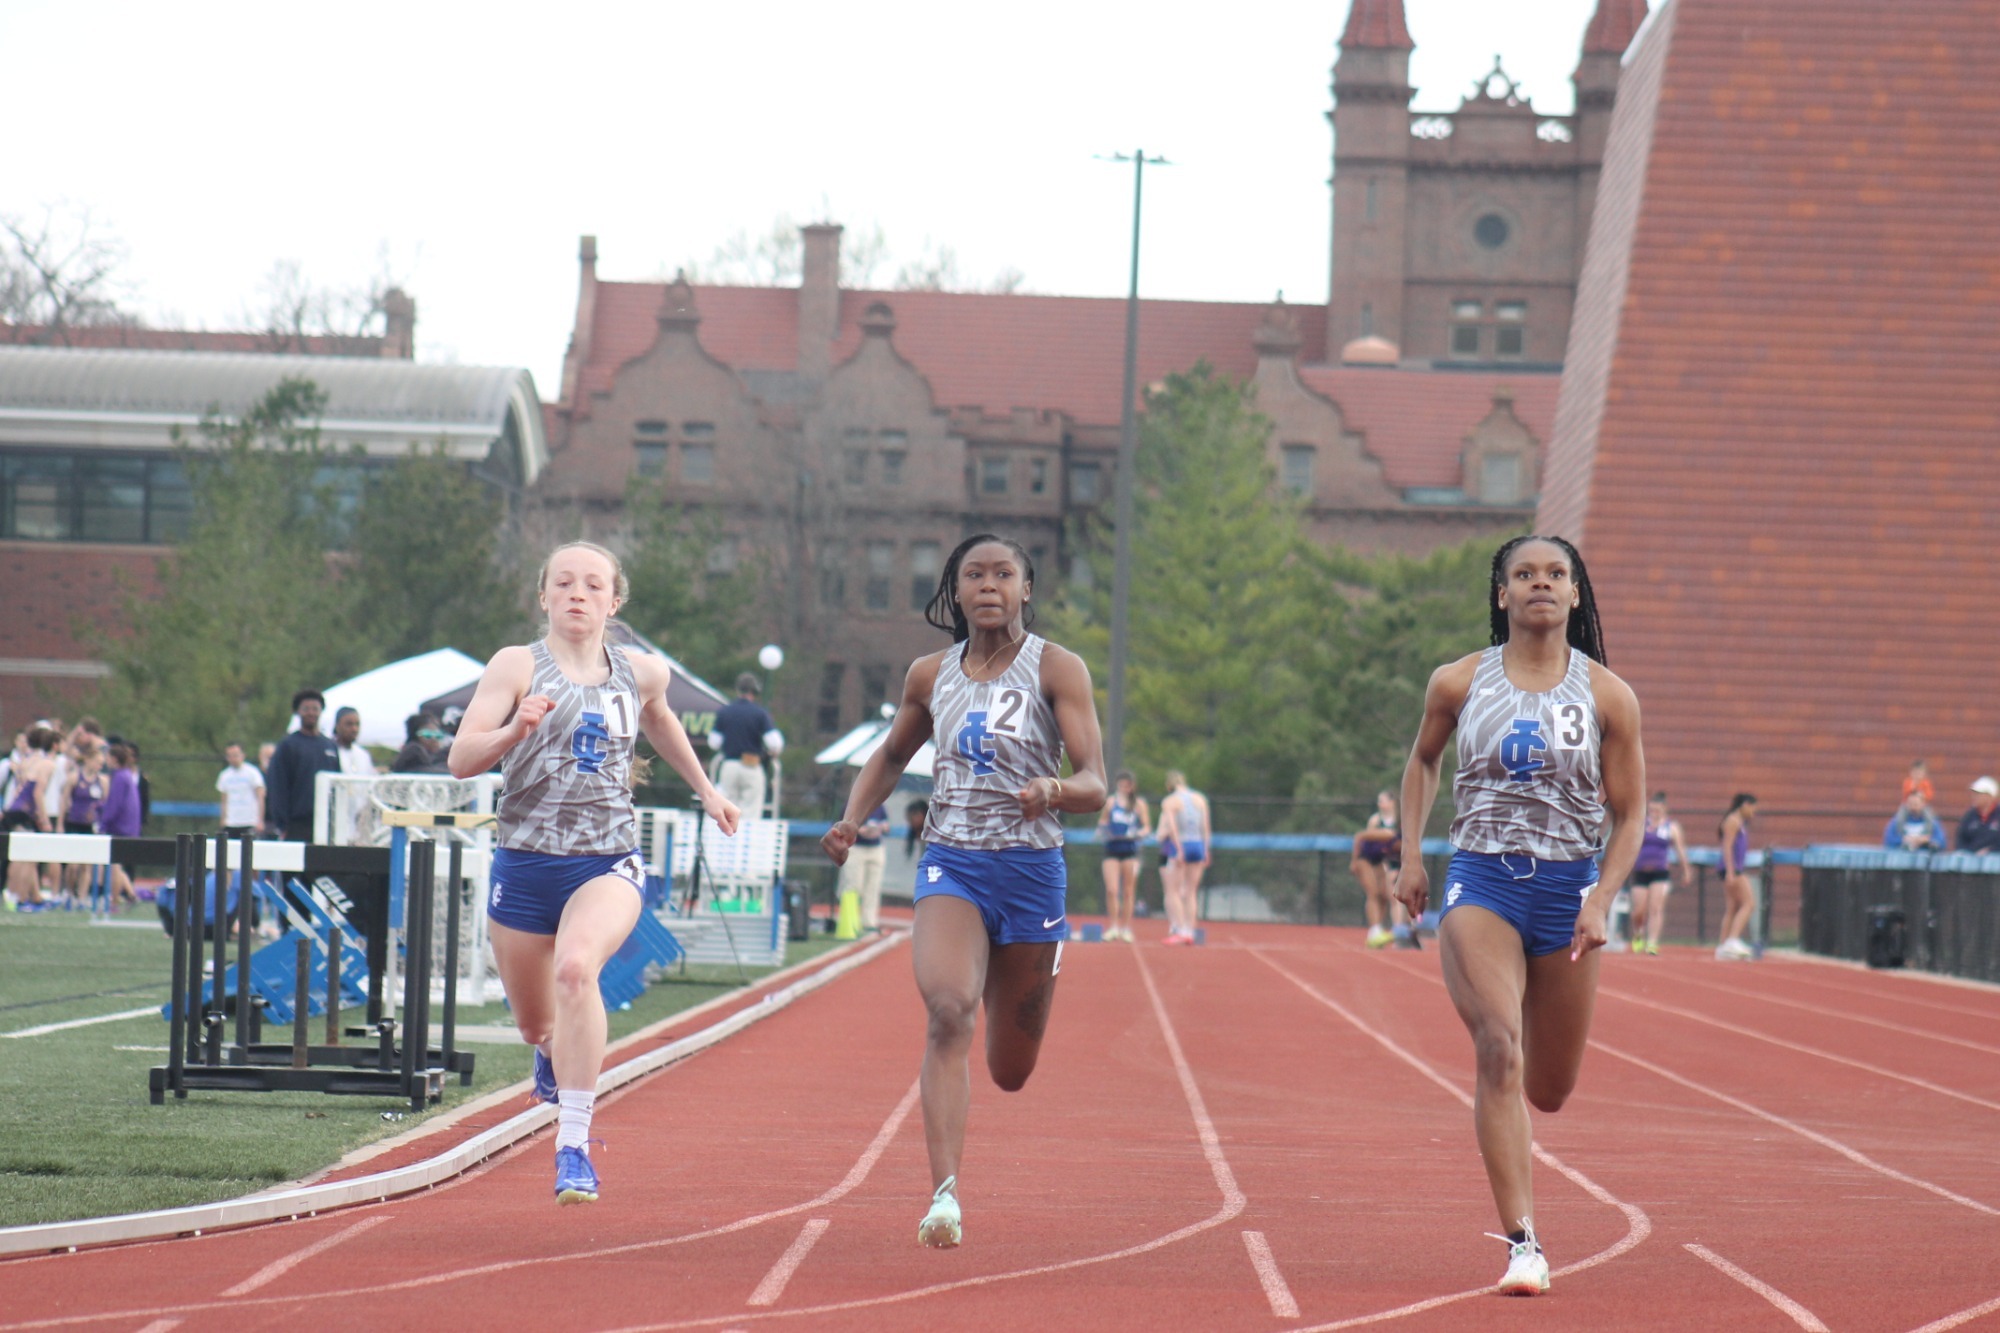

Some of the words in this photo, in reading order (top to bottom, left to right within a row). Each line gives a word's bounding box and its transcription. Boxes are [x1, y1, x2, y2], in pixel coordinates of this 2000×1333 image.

[611, 694, 629, 735] 1
[994, 689, 1023, 733] 2
[1561, 704, 1585, 747] 3
[315, 876, 355, 914] GILL
